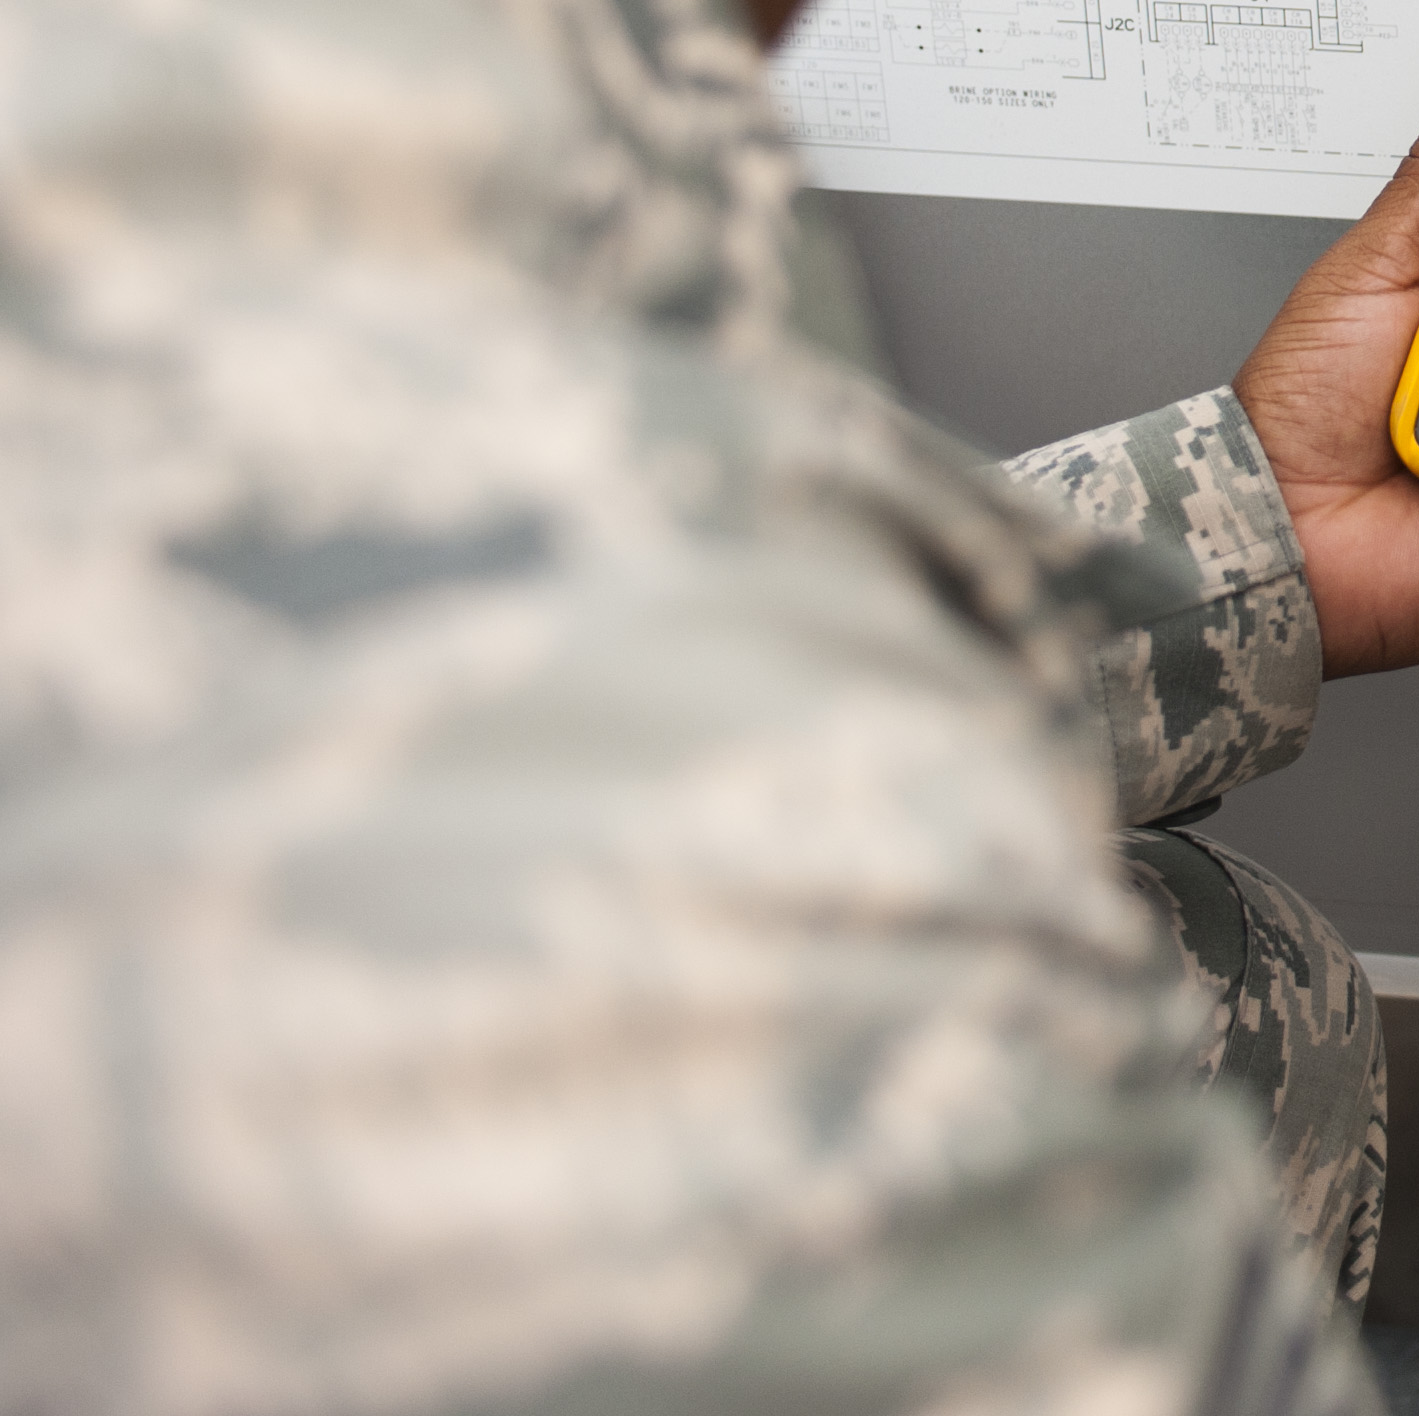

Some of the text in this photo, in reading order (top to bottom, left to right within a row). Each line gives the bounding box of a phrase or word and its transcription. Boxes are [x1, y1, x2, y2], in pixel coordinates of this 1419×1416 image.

[1104, 17, 1135, 32] J2C
[948, 85, 1057, 100] BRINE OPTION WIRING
[998, 97, 1027, 107] SIZES
[1031, 99, 1055, 109] ONLY
